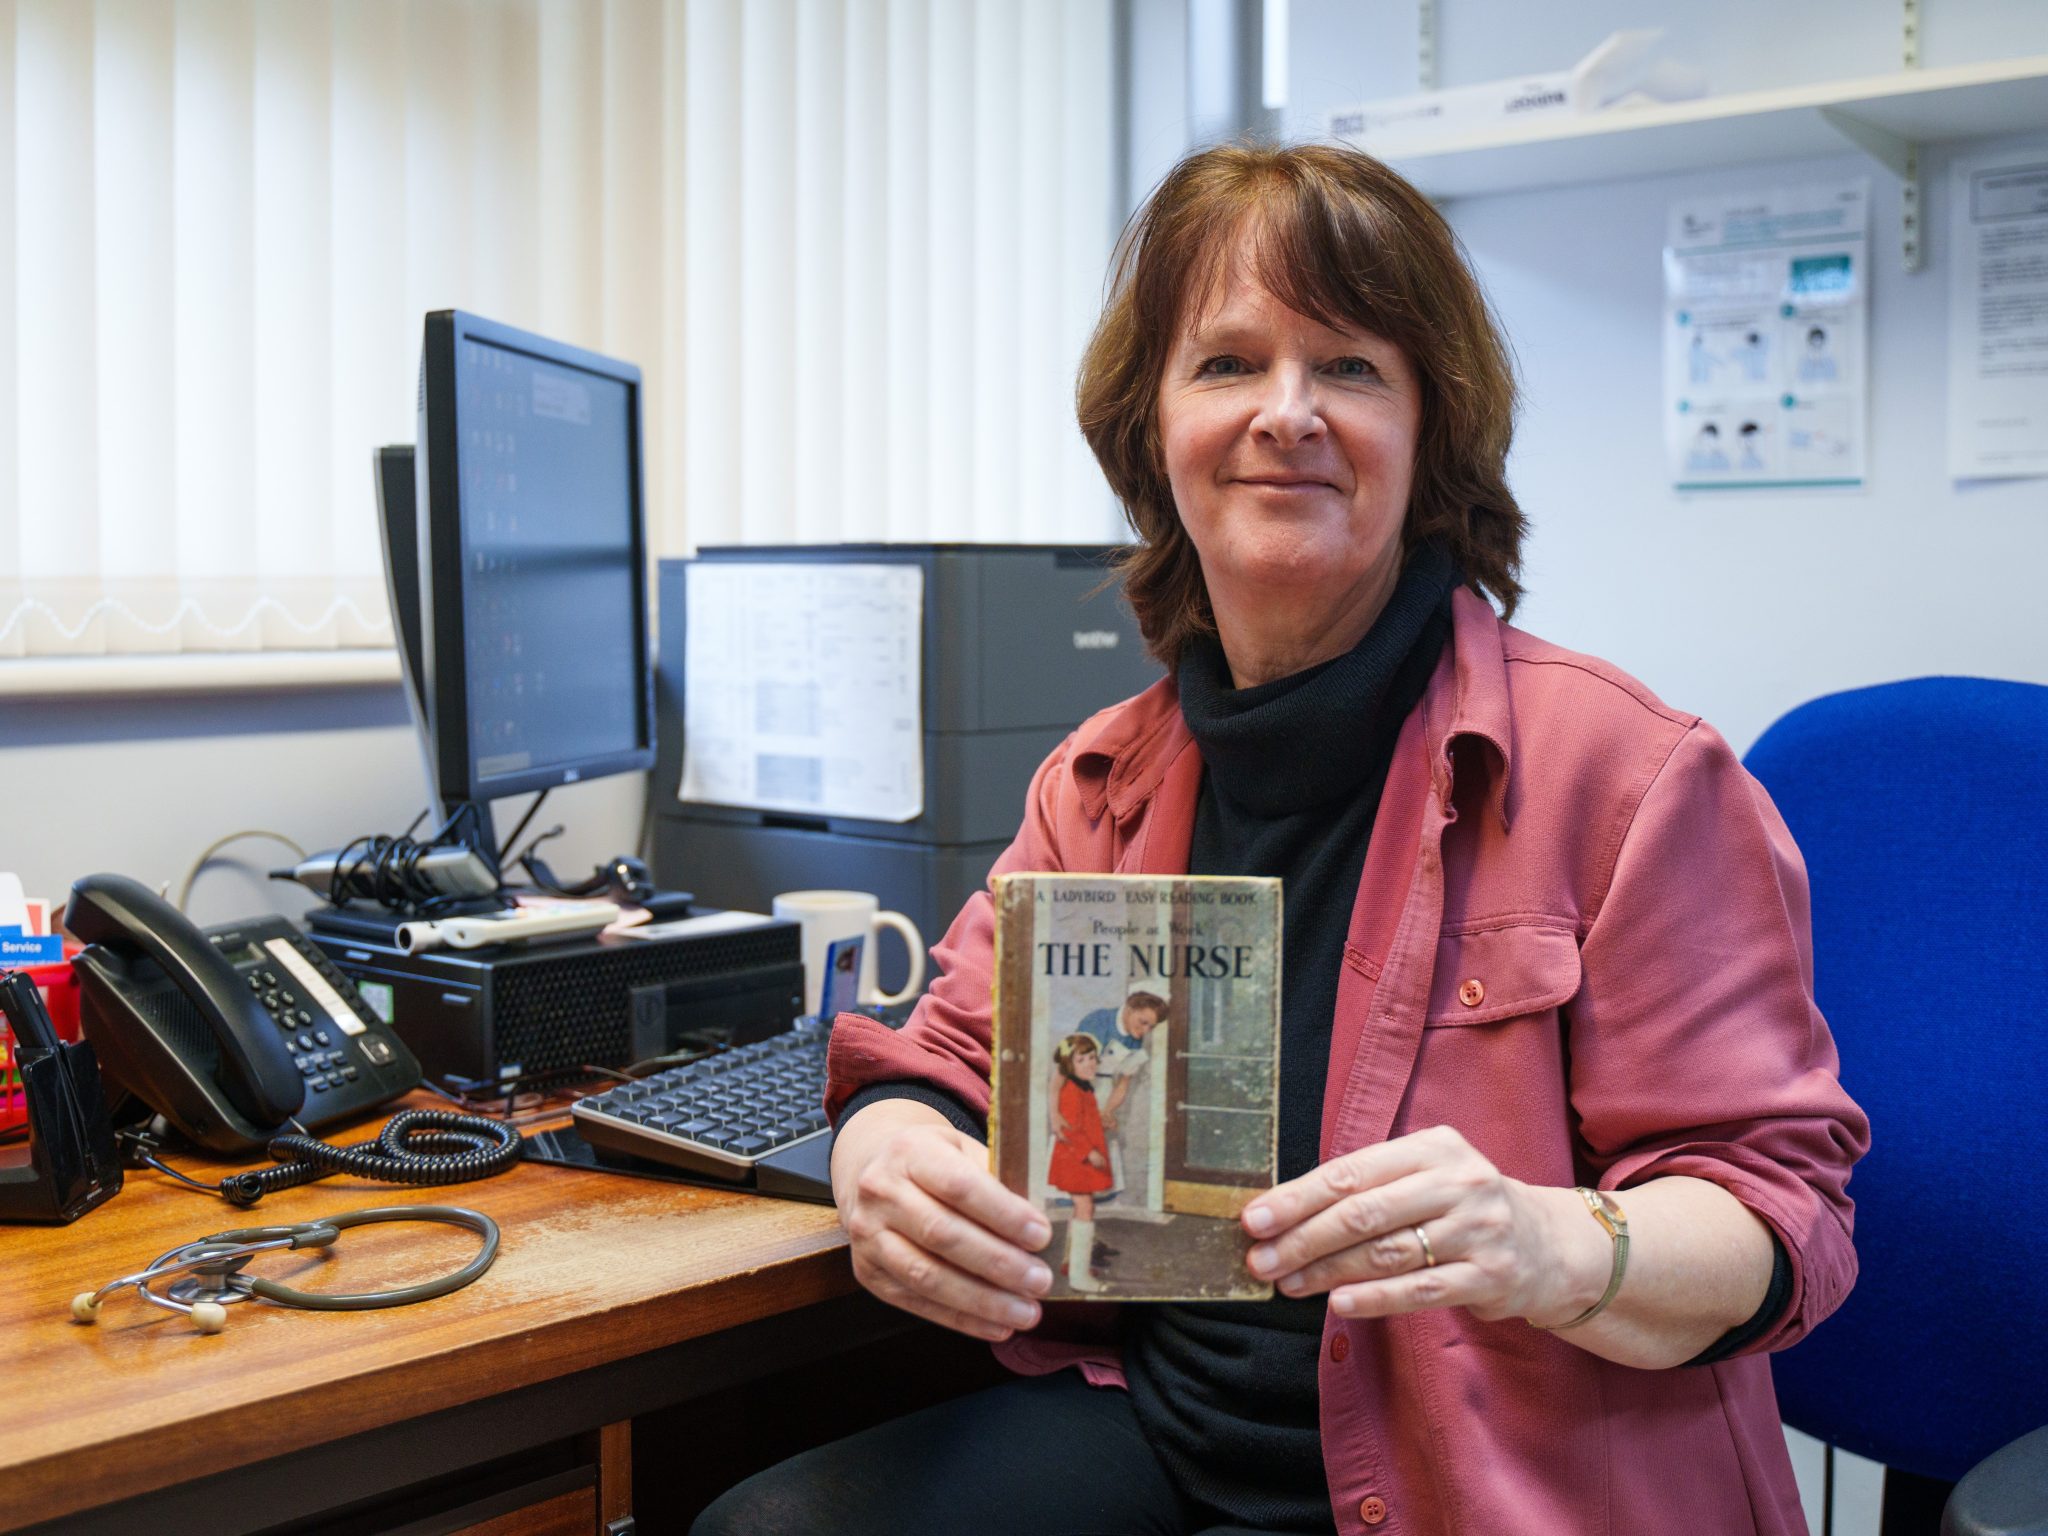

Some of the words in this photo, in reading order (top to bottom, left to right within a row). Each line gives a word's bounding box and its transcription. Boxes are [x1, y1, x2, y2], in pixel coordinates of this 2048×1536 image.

[1036, 889, 1045, 902] A
[1053, 889, 1116, 902] LADYBIRD
[1126, 890, 1155, 904] EASY
[1160, 891, 1214, 904] READING
[1221, 892, 1257, 905] BOOK
[2, 941, 42, 953] Service
[1038, 943, 1111, 976] THE
[1129, 944, 1253, 978] NURSE
